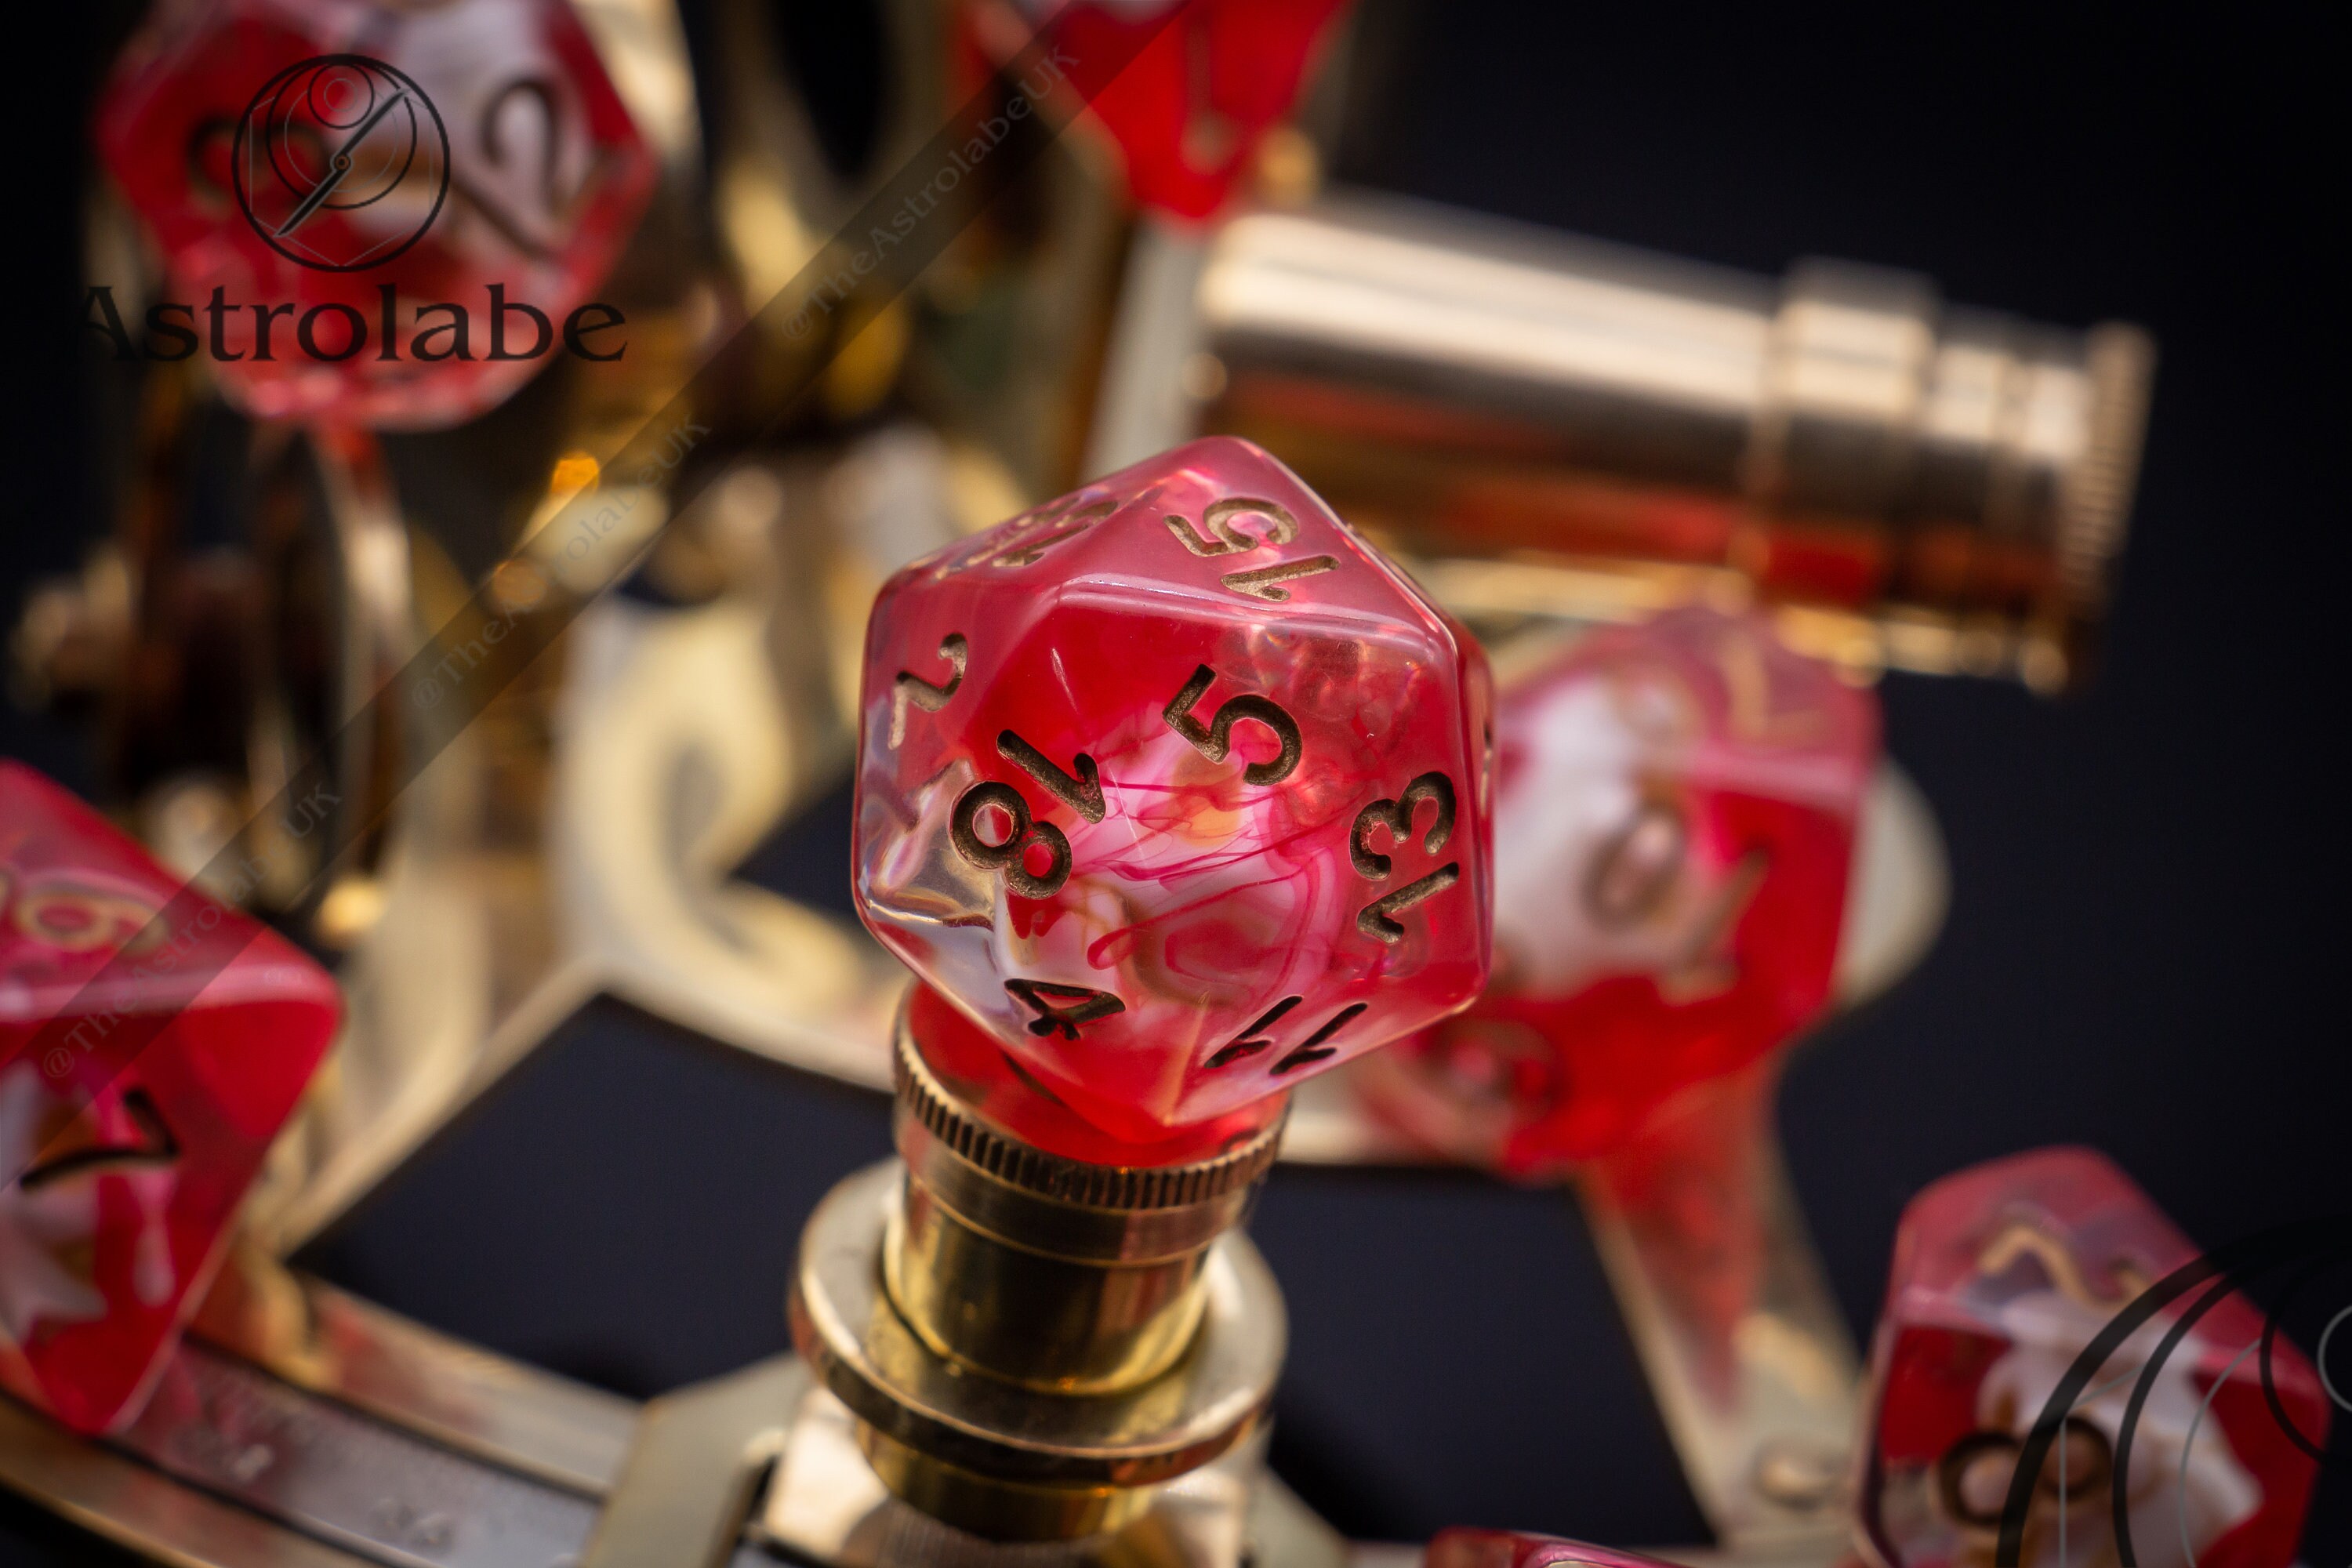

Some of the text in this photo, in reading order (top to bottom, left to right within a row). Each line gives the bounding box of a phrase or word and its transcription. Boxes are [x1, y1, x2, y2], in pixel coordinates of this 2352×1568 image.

[1163, 497, 1341, 602] 15
[887, 633, 968, 750] 2
[1163, 664, 1303, 786] 5
[949, 730, 1107, 900] 18
[1350, 771, 1460, 943] 13
[1004, 978, 1127, 1041] 4
[1203, 995, 1368, 1076] 11
